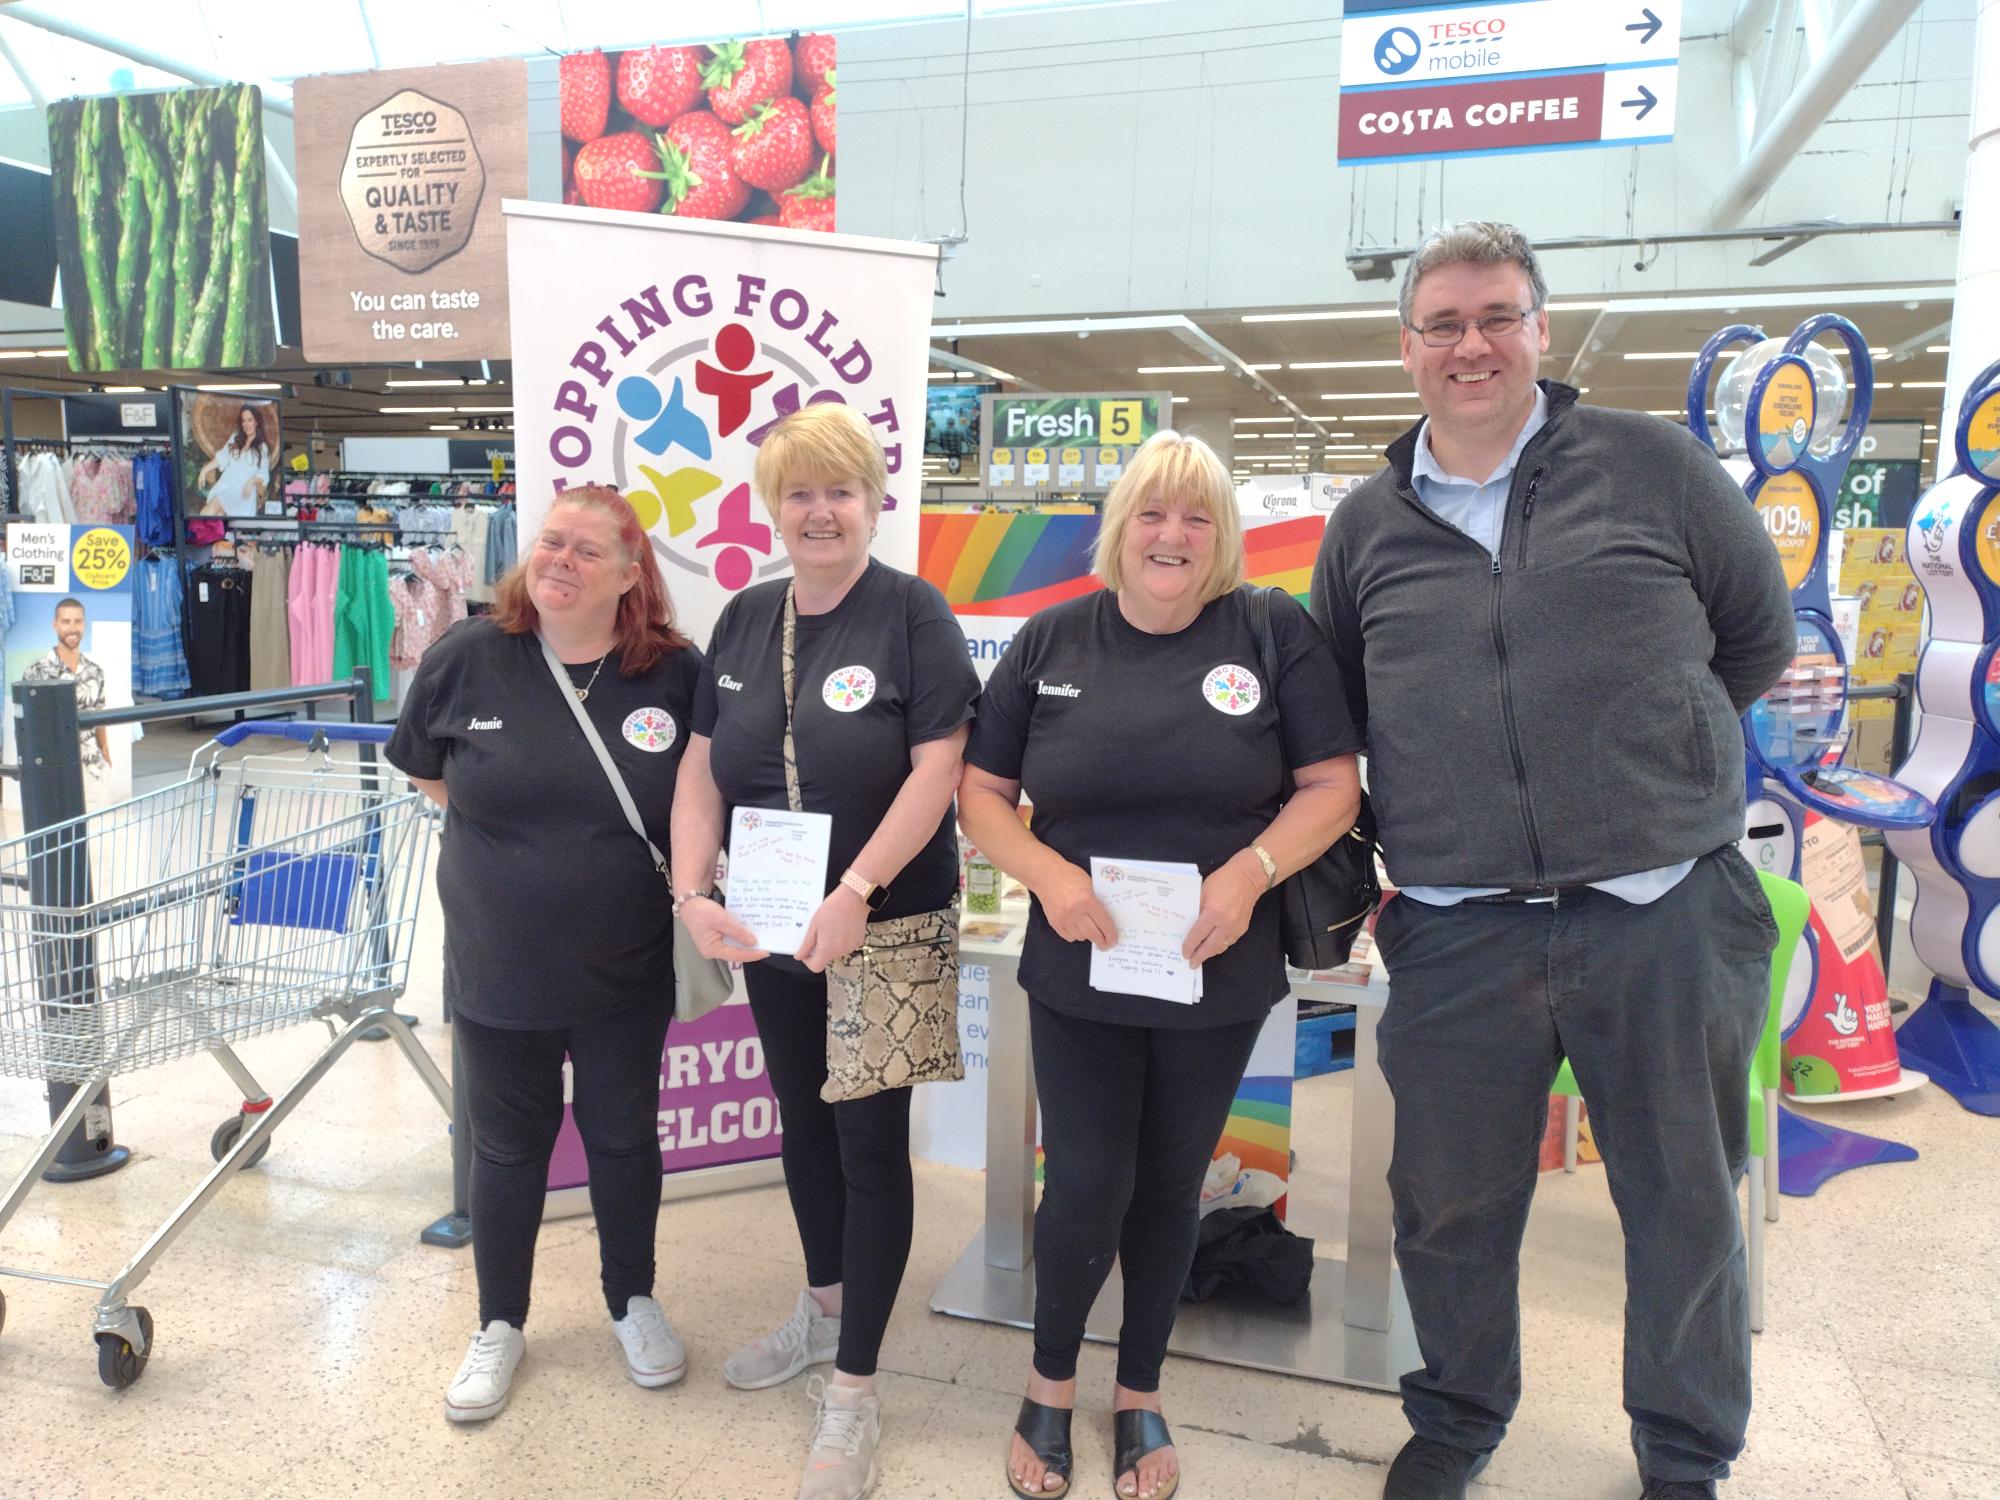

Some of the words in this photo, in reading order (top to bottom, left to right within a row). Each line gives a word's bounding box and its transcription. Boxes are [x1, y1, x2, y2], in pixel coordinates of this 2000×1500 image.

[1428, 18, 1506, 40] TESCO
[1429, 48, 1500, 71] mobile
[381, 111, 438, 130] TESCO
[1359, 107, 1454, 135] COSTA
[1465, 97, 1579, 127] COFFEE
[356, 153, 408, 168] EXPERTLY
[411, 150, 467, 165] SELECTED
[400, 168, 421, 178] FOR
[366, 182, 459, 208] QUALITY
[375, 214, 388, 235] &
[392, 211, 452, 233] TASTE
[388, 240, 417, 251] SINCE
[350, 291, 385, 311] You
[390, 294, 426, 310] can
[431, 289, 480, 309] taste
[372, 319, 405, 340] the
[410, 321, 459, 339] care.
[734, 273, 872, 384] FOLD
[124, 407, 152, 422] F&F
[1007, 406, 1093, 438] Fresh
[1111, 407, 1130, 436] 5
[1850, 467, 1887, 495] of
[1262, 494, 1298, 510] Corona
[21, 533, 56, 545] Men's
[86, 535, 119, 547] Save
[12, 547, 65, 562] Clothing
[78, 548, 126, 570] 25%
[22, 567, 53, 582] F&F
[1922, 562, 1953, 570] NATIONAL
[1926, 569, 1954, 577] LOTTERY
[718, 674, 743, 692] Clare
[1037, 680, 1081, 698] Jennifer
[468, 717, 503, 730] Jennie
